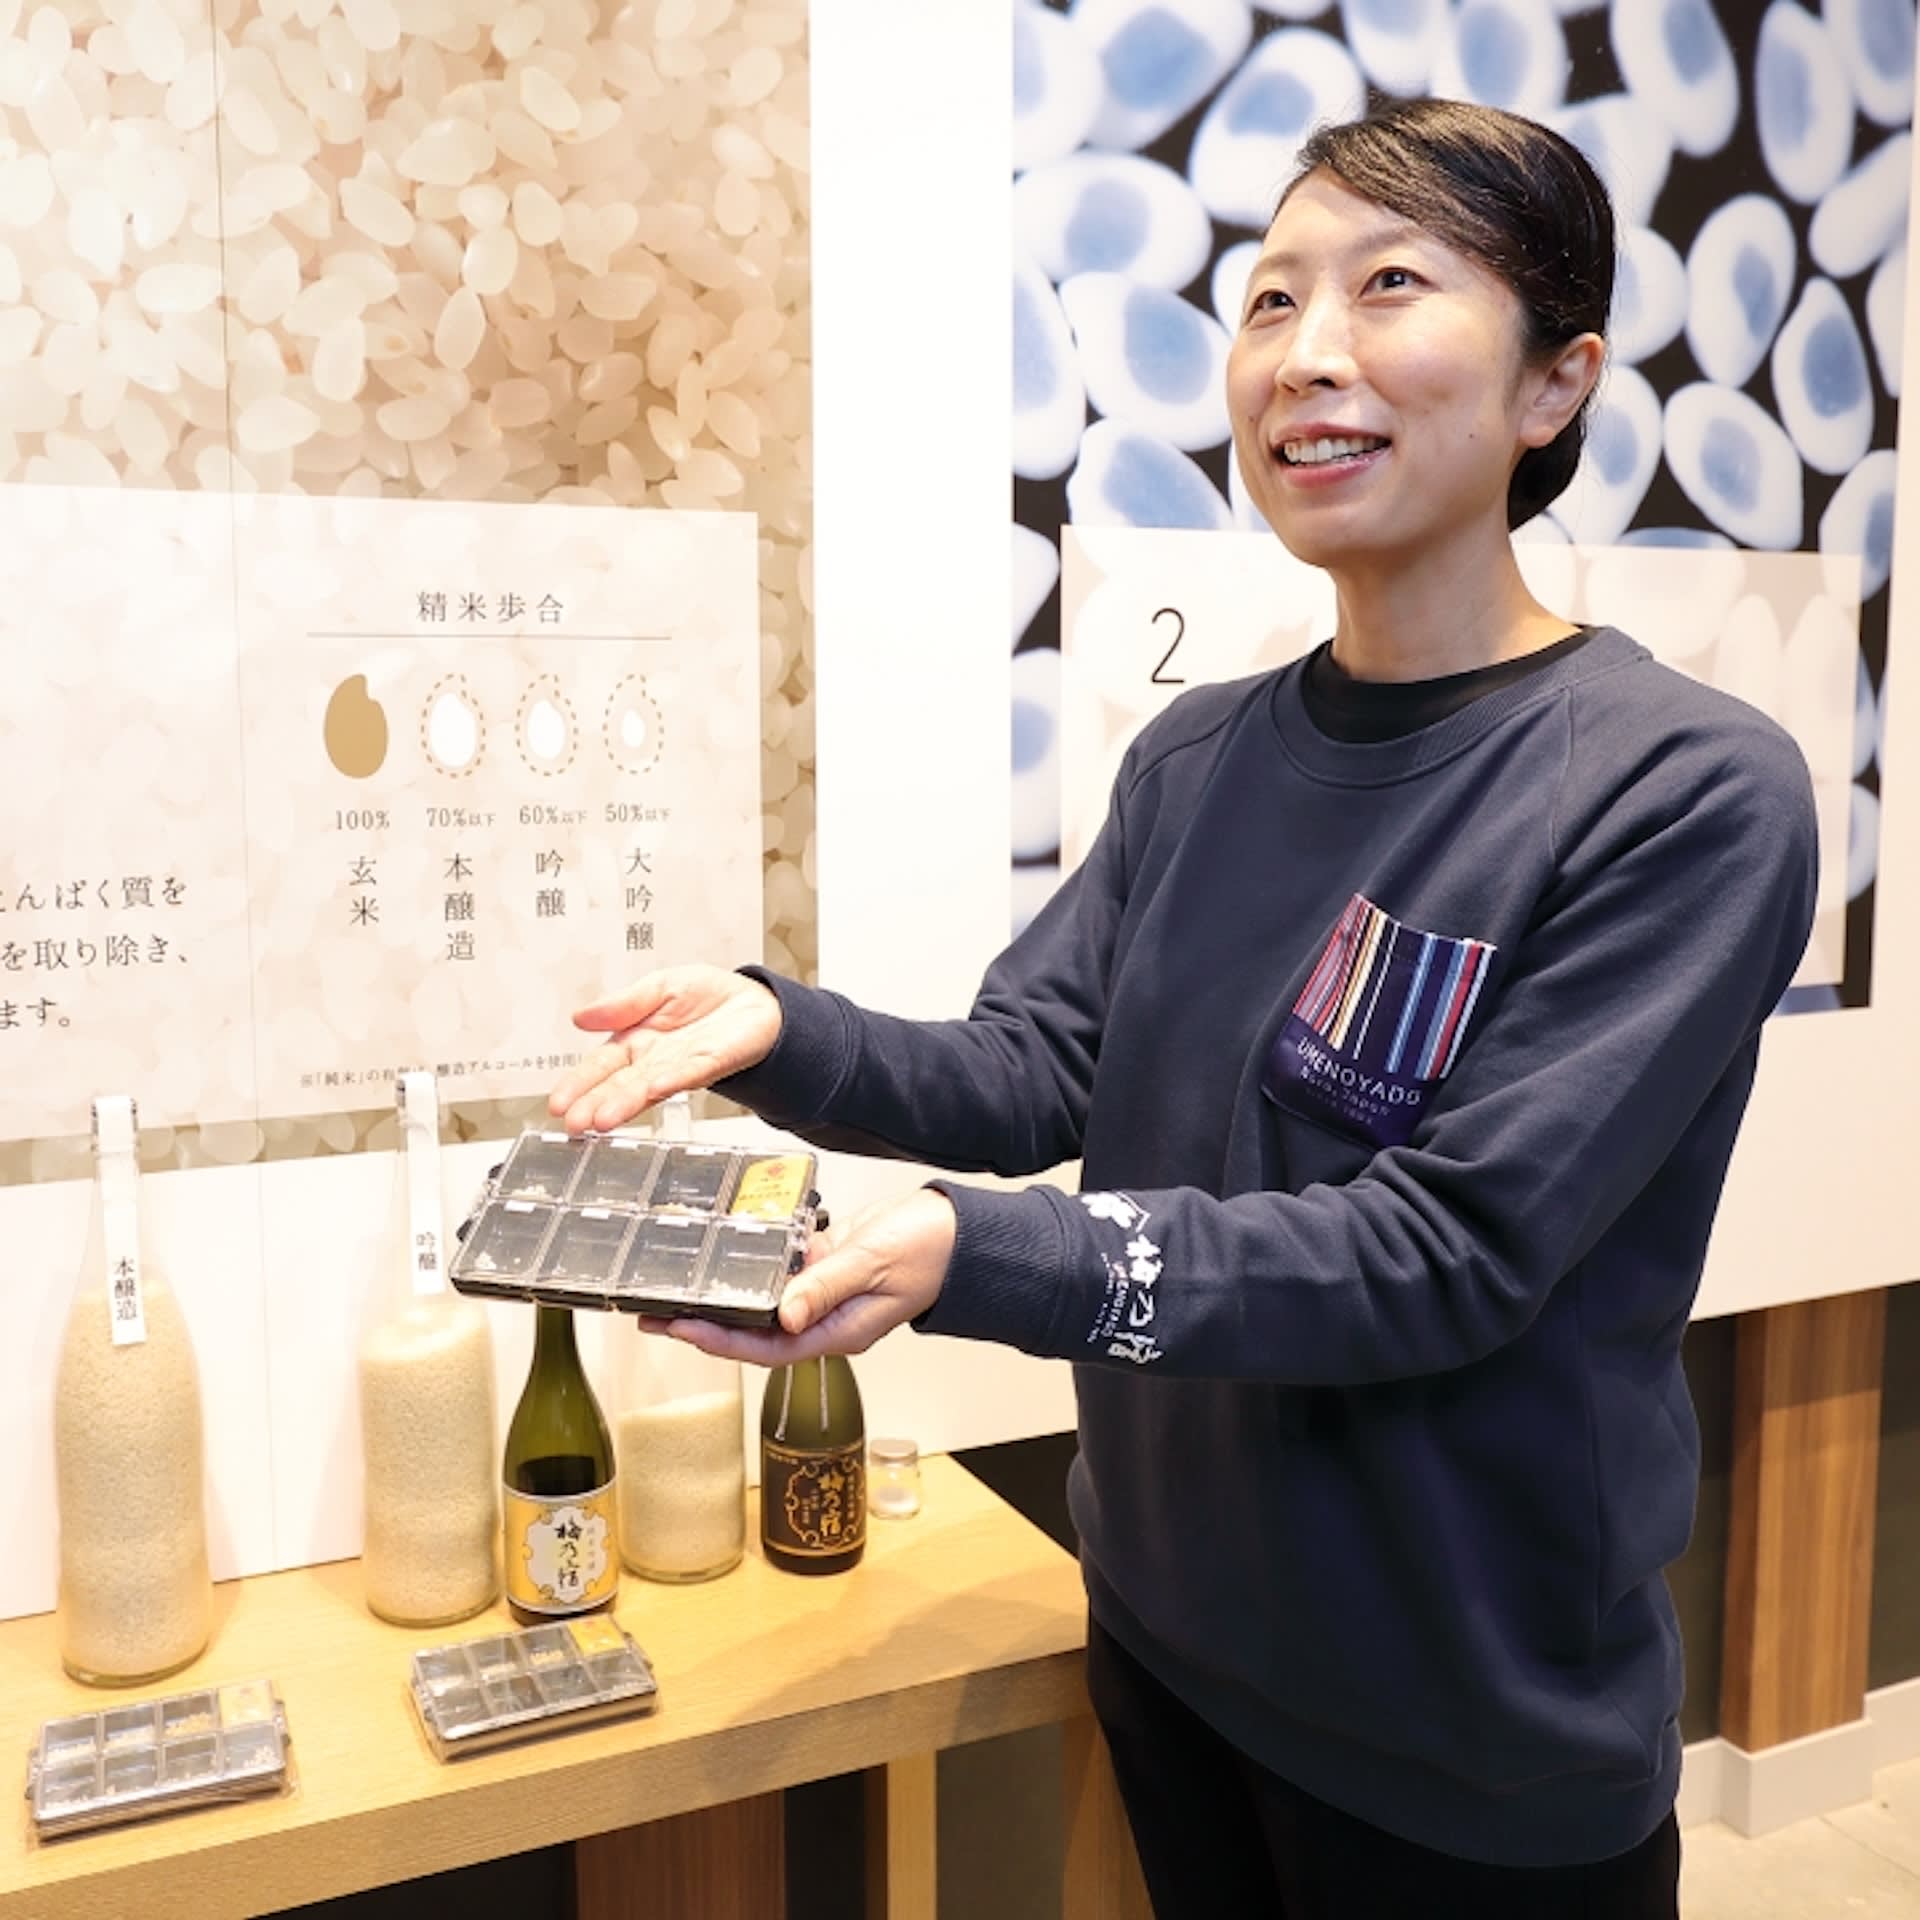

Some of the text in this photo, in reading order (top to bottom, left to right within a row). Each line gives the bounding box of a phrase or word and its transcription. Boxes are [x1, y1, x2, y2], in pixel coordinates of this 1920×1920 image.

[416, 591, 565, 623] 精米歩合
[1151, 607, 1185, 684] 2
[335, 809, 391, 830] 100%
[426, 807, 496, 828] 70%以下
[0, 875, 187, 913] んぱく質を
[348, 856, 380, 927] 玄米
[443, 852, 476, 961] 本醸造
[535, 848, 566, 918] 吟醸
[624, 847, 655, 951] 大吟醸
[1, 933, 188, 971] を取り除き、
[0, 996, 71, 1030] ます。
[1297, 1036, 1421, 1106] UMENOYADO
[416, 1231, 438, 1272] 吟醸
[113, 1256, 138, 1322] 本醸造
